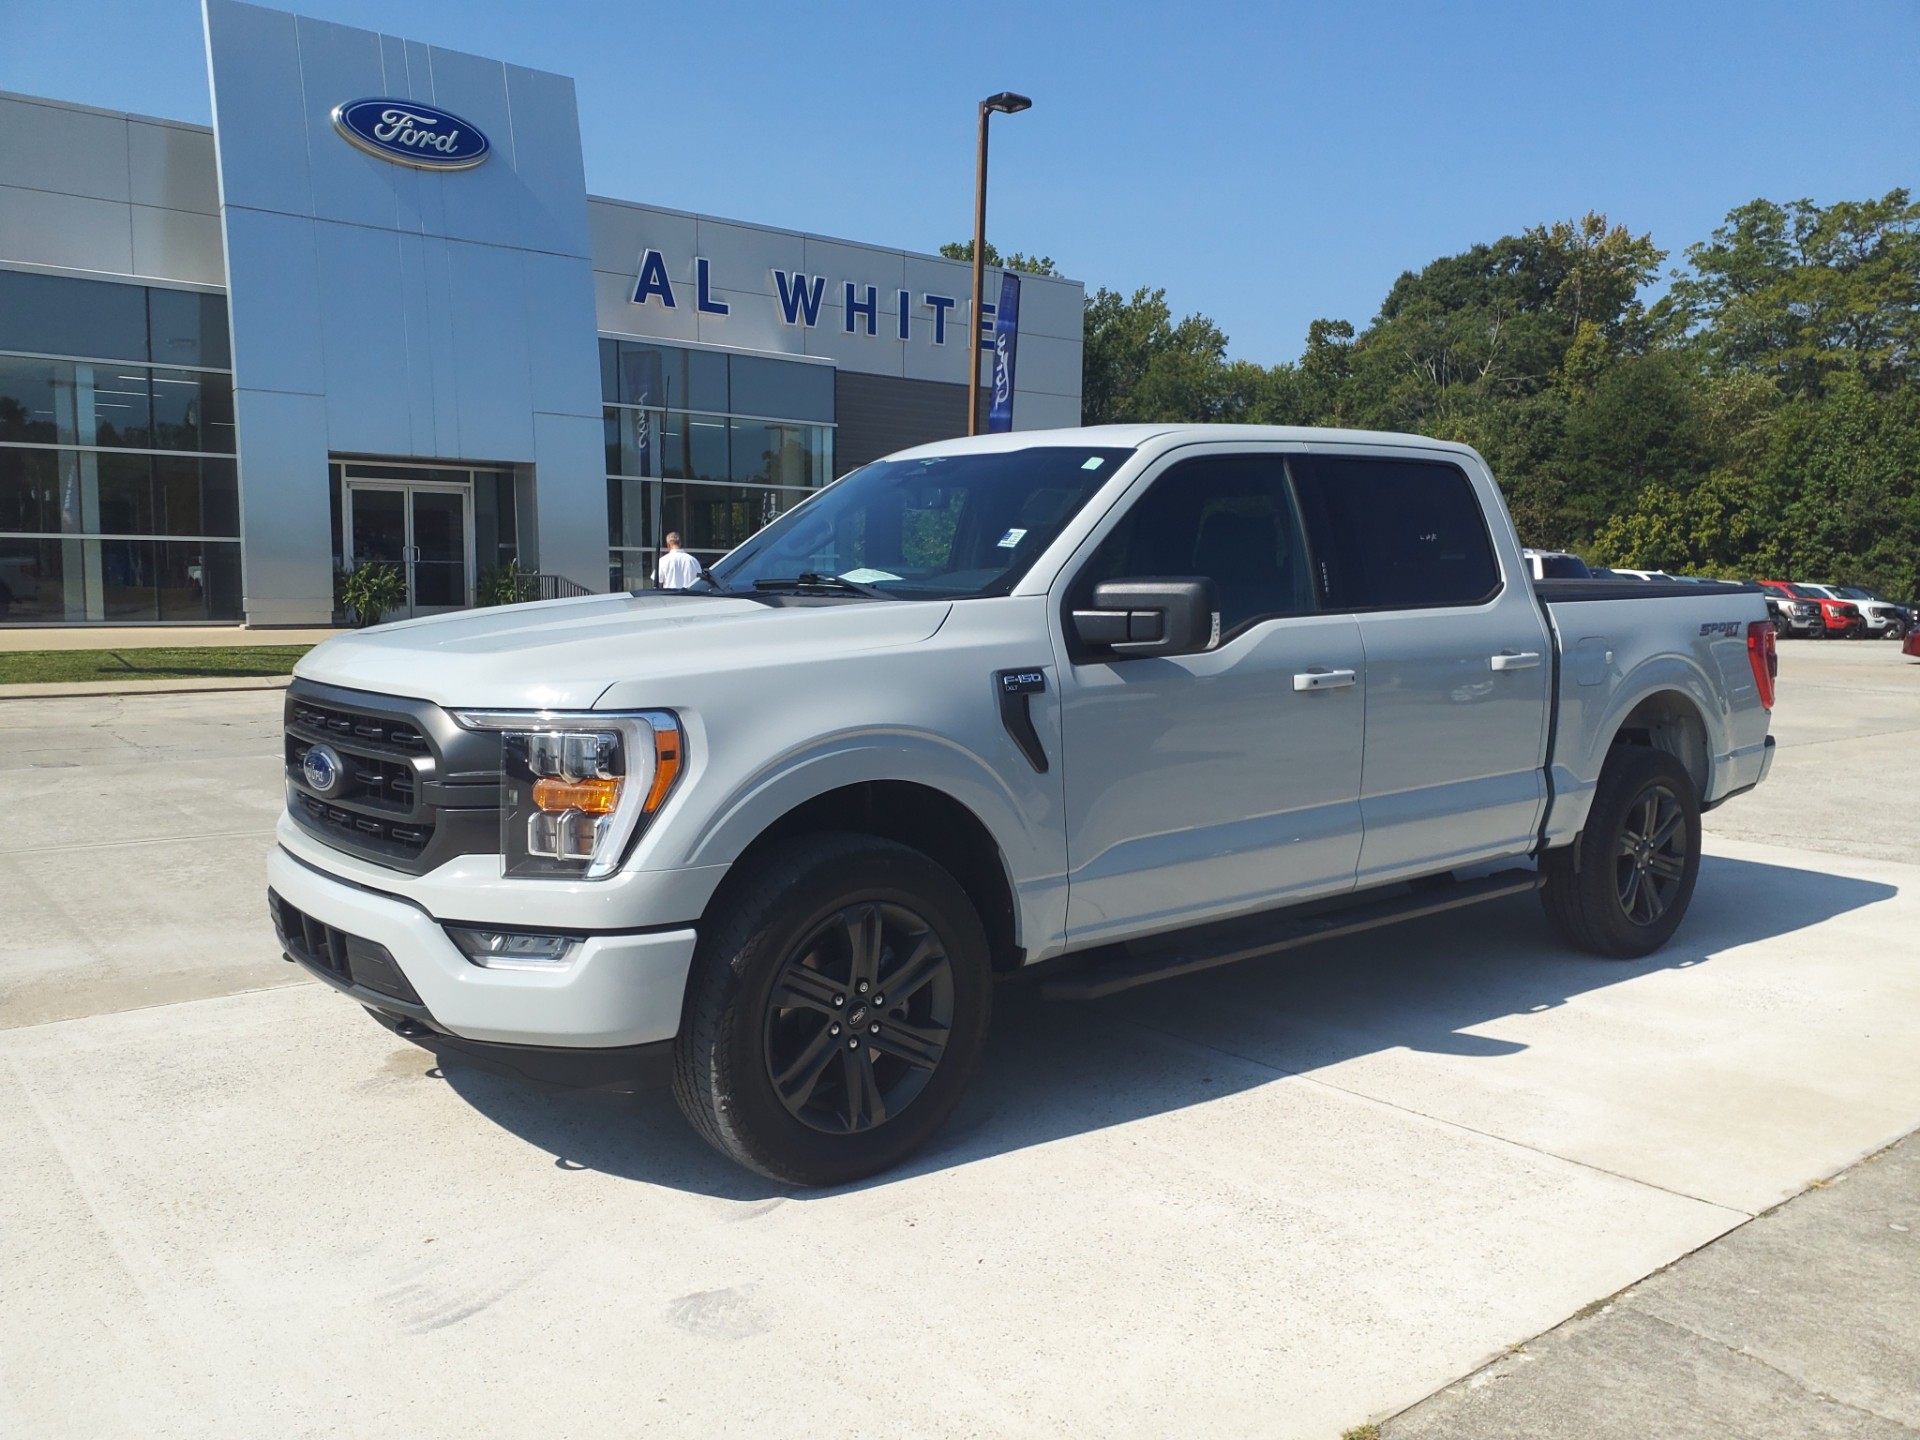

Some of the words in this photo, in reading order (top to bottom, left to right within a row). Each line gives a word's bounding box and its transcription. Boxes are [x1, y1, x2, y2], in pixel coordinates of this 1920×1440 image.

[374, 109, 459, 153] Ford
[631, 248, 731, 317] AL
[771, 268, 998, 352] WHITE
[1699, 621, 1741, 636] SPORT
[1003, 673, 1042, 684] F-150
